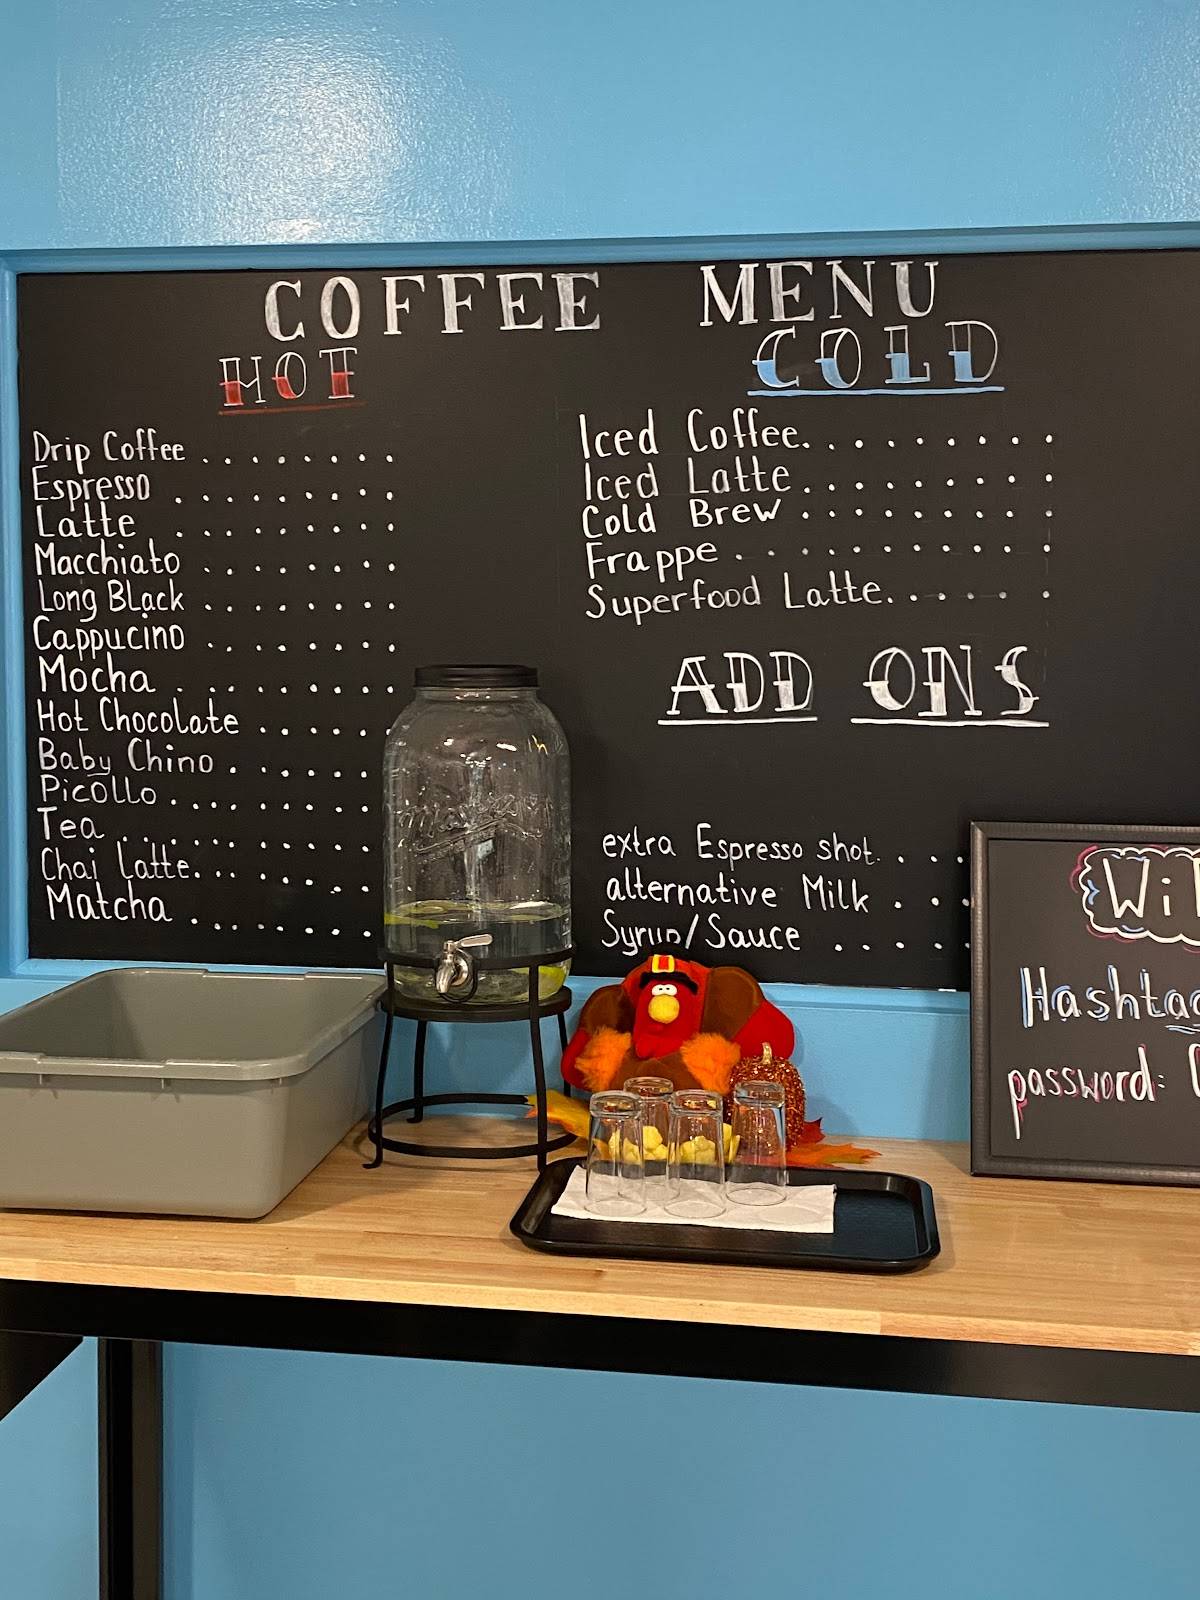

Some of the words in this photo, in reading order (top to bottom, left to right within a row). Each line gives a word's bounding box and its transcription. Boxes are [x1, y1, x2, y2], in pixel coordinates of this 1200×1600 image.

[264, 272, 600, 341] COFFEE
[700, 261, 939, 326] MENU
[752, 320, 998, 389] COLD
[218, 347, 358, 406] HOT
[33, 431, 91, 474] Drip
[103, 428, 185, 462] Coffee
[579, 409, 659, 459] Iced
[687, 408, 799, 453] Coffee
[32, 465, 150, 512] Espresso
[583, 462, 659, 500] Iced
[687, 456, 792, 494] Latte
[36, 501, 136, 538] Latte
[582, 504, 657, 539] Cold
[690, 499, 782, 529] Brew
[34, 538, 180, 576] Macchiato
[585, 540, 718, 583] Frappe
[39, 579, 97, 622] Long
[585, 576, 761, 626] Superfood
[784, 570, 882, 610] Latte
[32, 613, 185, 661] Cappucino
[38, 652, 156, 693] Mocha
[666, 650, 813, 715] ADD
[862, 645, 1039, 717] ONS
[37, 698, 88, 733] Hot
[100, 697, 239, 735] Chocolate
[38, 737, 111, 775] Baby
[127, 738, 214, 773] Chino
[41, 774, 156, 805] Picollo
[37, 806, 105, 840] Tea
[41, 847, 97, 881] Chai
[602, 826, 676, 859] extra
[696, 823, 803, 871] Espresso
[46, 881, 172, 921] Matcha
[606, 872, 778, 907] alternative
[802, 874, 869, 913] Milk
